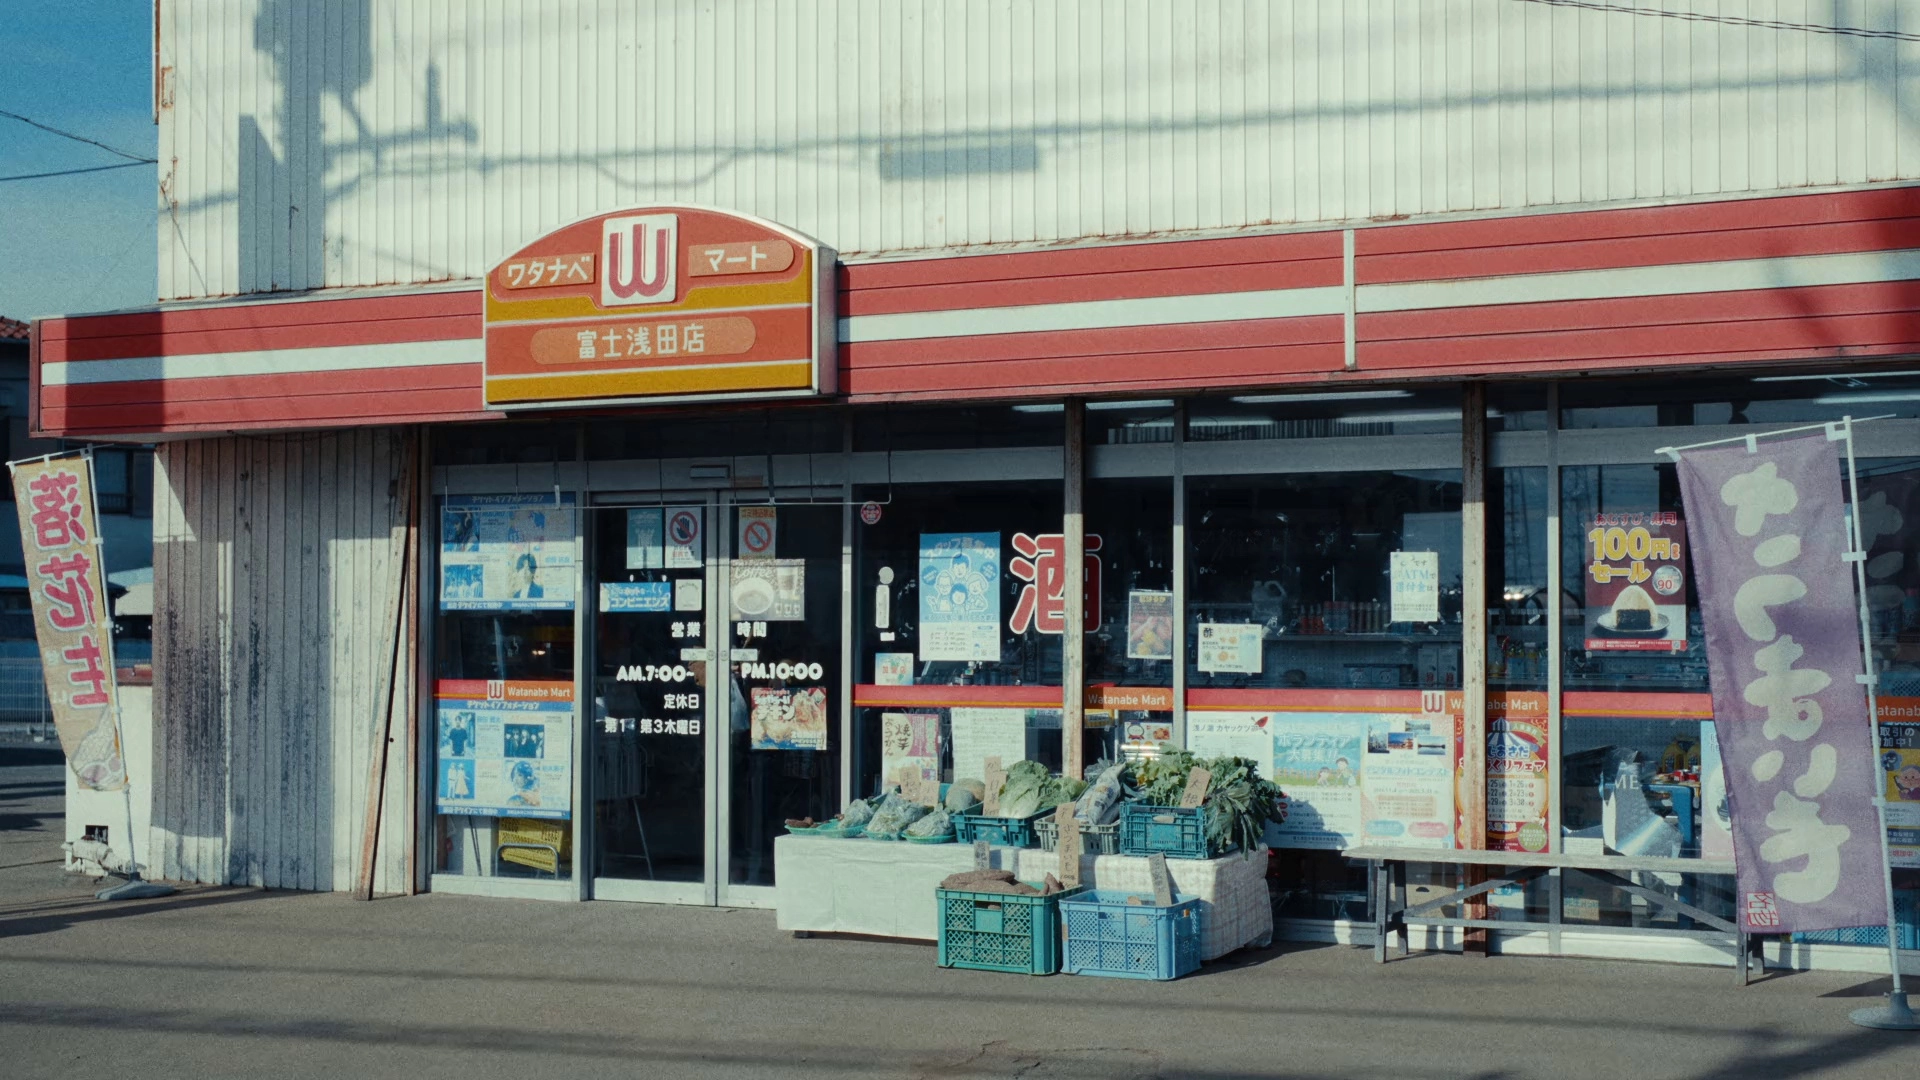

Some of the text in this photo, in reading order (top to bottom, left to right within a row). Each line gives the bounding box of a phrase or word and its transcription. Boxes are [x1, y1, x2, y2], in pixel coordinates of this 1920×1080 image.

[506, 245, 767, 287] ワタナベ マート
[576, 323, 705, 360] 富士浅田店
[1594, 512, 1677, 526] おむすび・寿司
[925, 536, 996, 563] スタッフ募集中
[1588, 526, 1670, 561] 100円
[734, 567, 772, 580] Coffee
[1589, 561, 1651, 583] セール
[1009, 532, 1103, 635] 酒
[610, 596, 670, 608] コンビニエンス
[671, 621, 767, 638] 営業 時間
[741, 662, 823, 680] PM.10:00
[507, 686, 571, 698] Watanabe Mart
[1088, 694, 1166, 706] Watanabe Mart
[663, 693, 700, 709] 定休日
[1511, 697, 1539, 710] Mart
[640, 718, 701, 735] 第3木曜日
[895, 723, 912, 751] 焼芋
[1278, 734, 1351, 749] ボランティア
